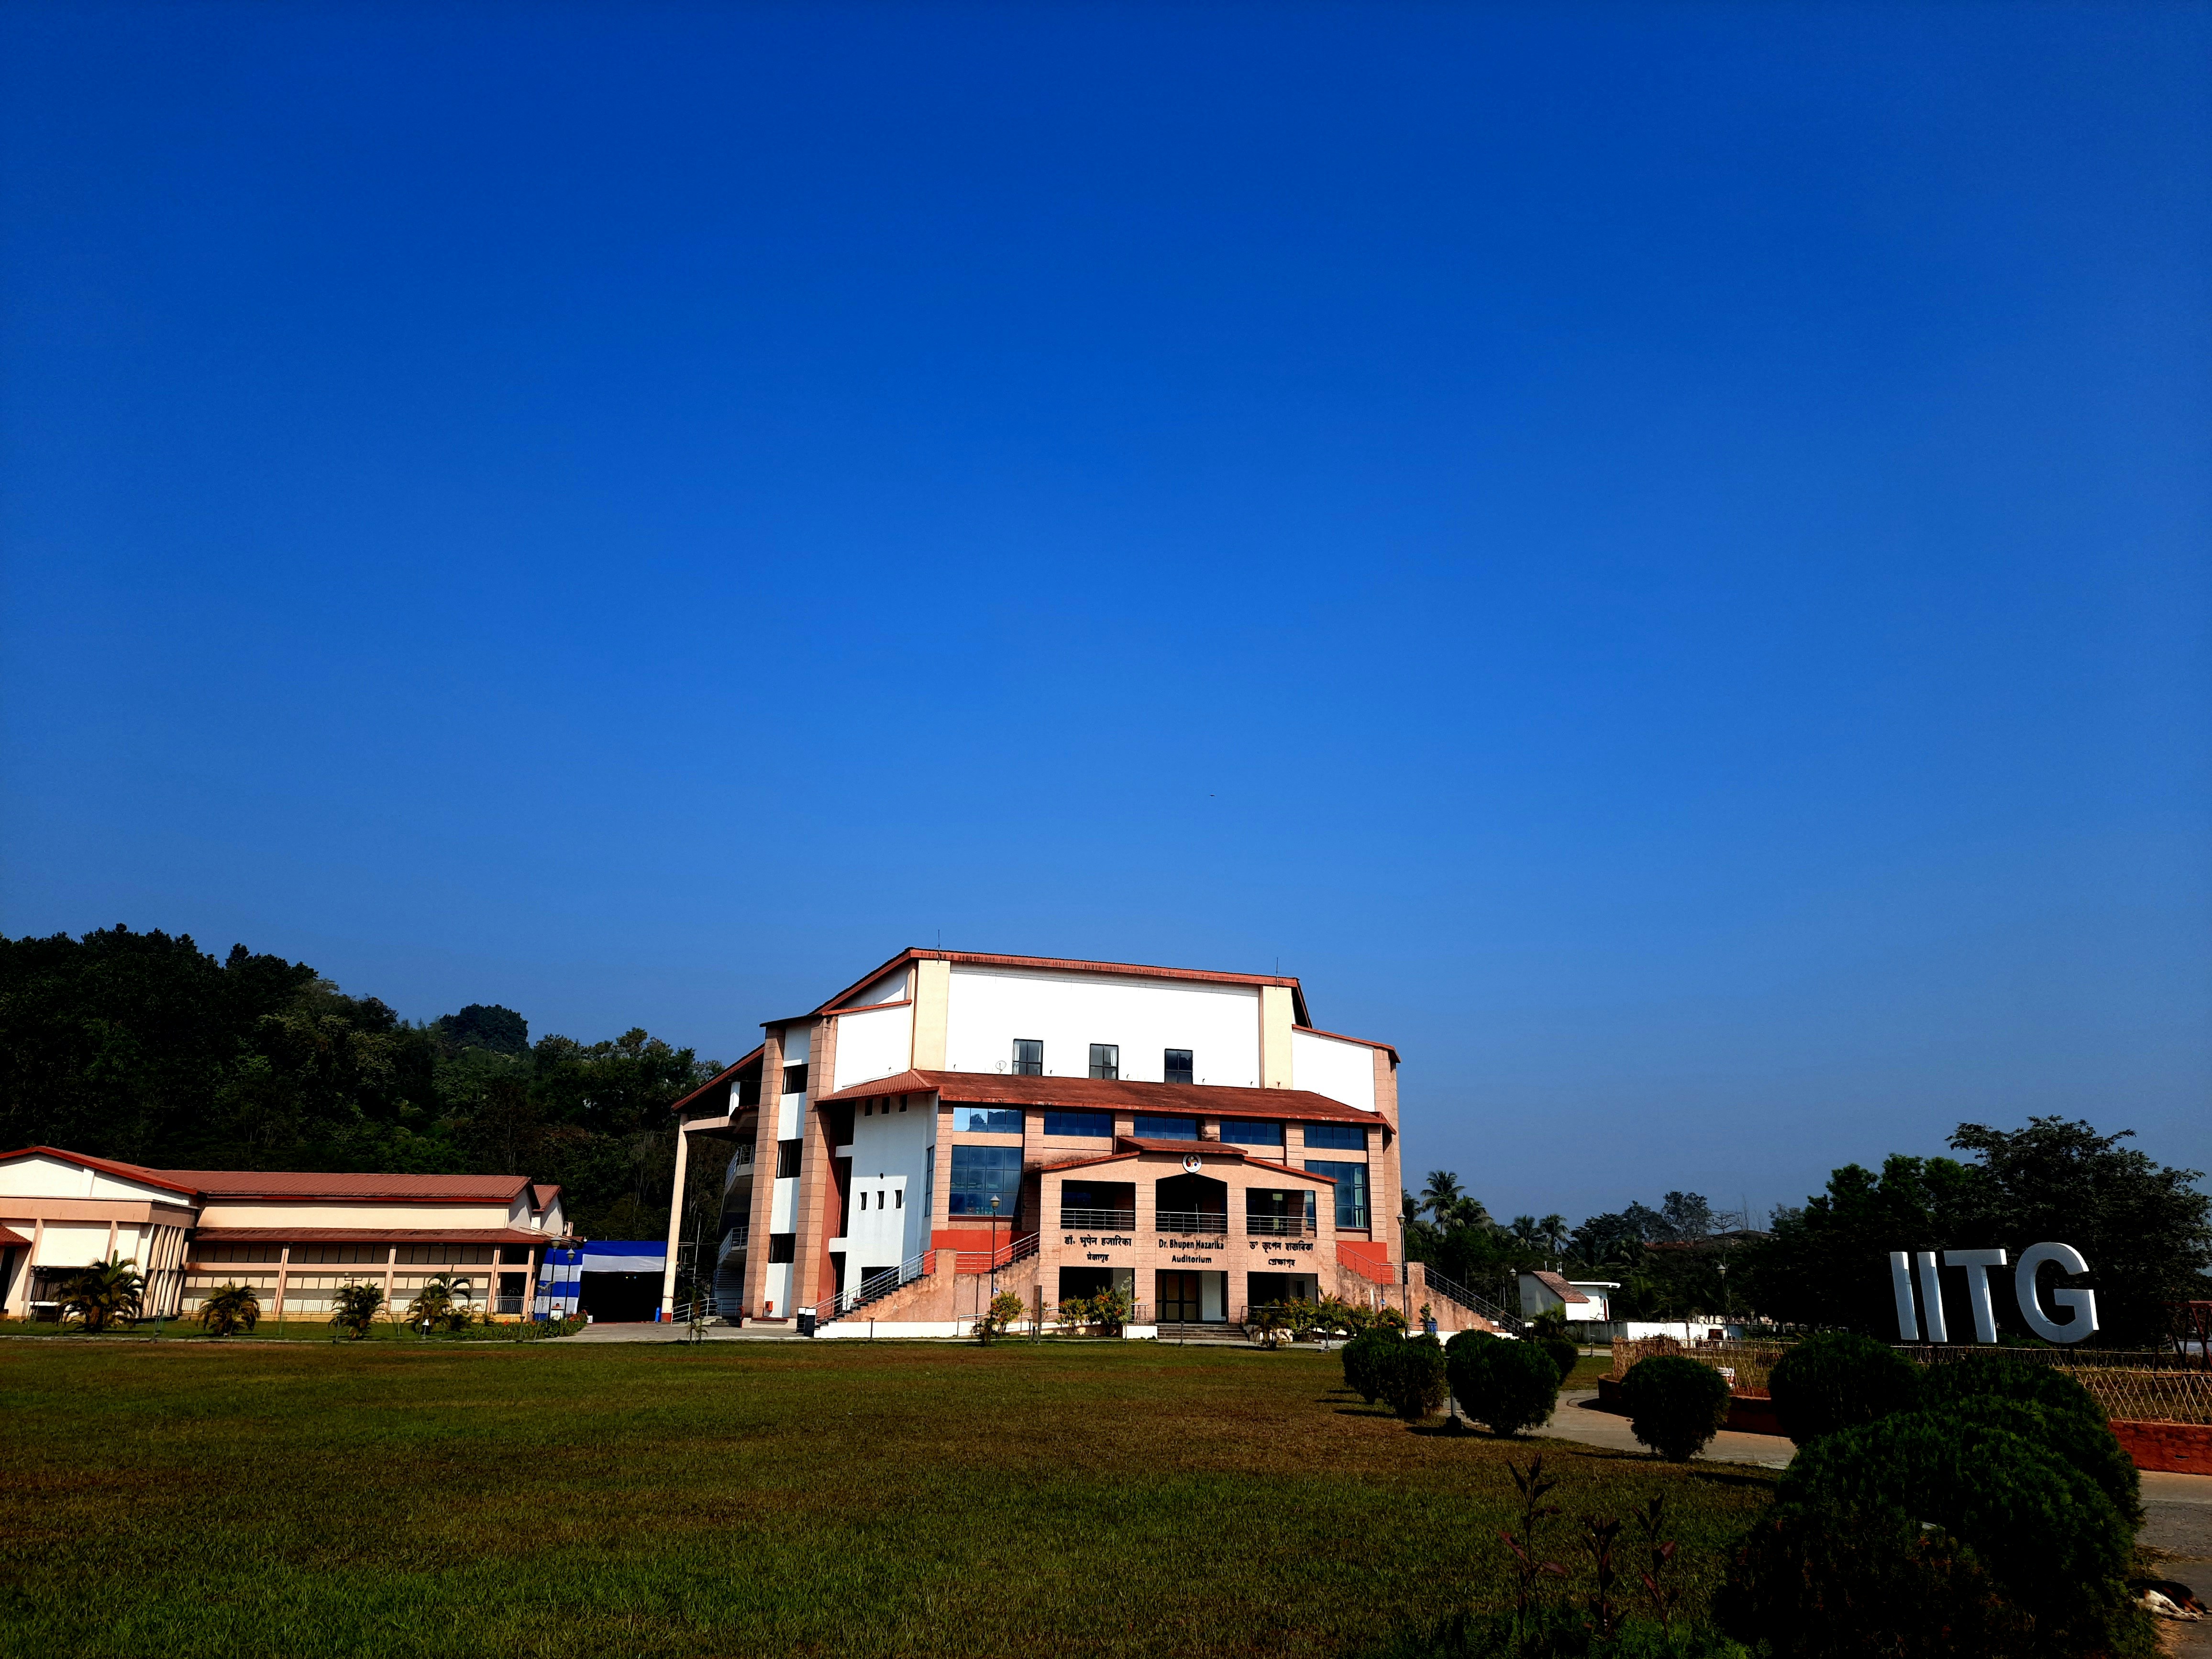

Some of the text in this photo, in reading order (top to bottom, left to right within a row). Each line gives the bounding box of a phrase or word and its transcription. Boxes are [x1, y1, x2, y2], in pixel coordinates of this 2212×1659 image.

[1080, 1234, 1097, 1247] भूपेन
[1101, 1235, 1132, 1246] हजारिका
[1159, 1239, 1224, 1250] Dr. Bhupen Hazarika
[1261, 1242, 1282, 1253] ভূপেন
[1172, 1254, 1212, 1263] Auditorium
[1890, 1242, 2099, 1343] IITG
